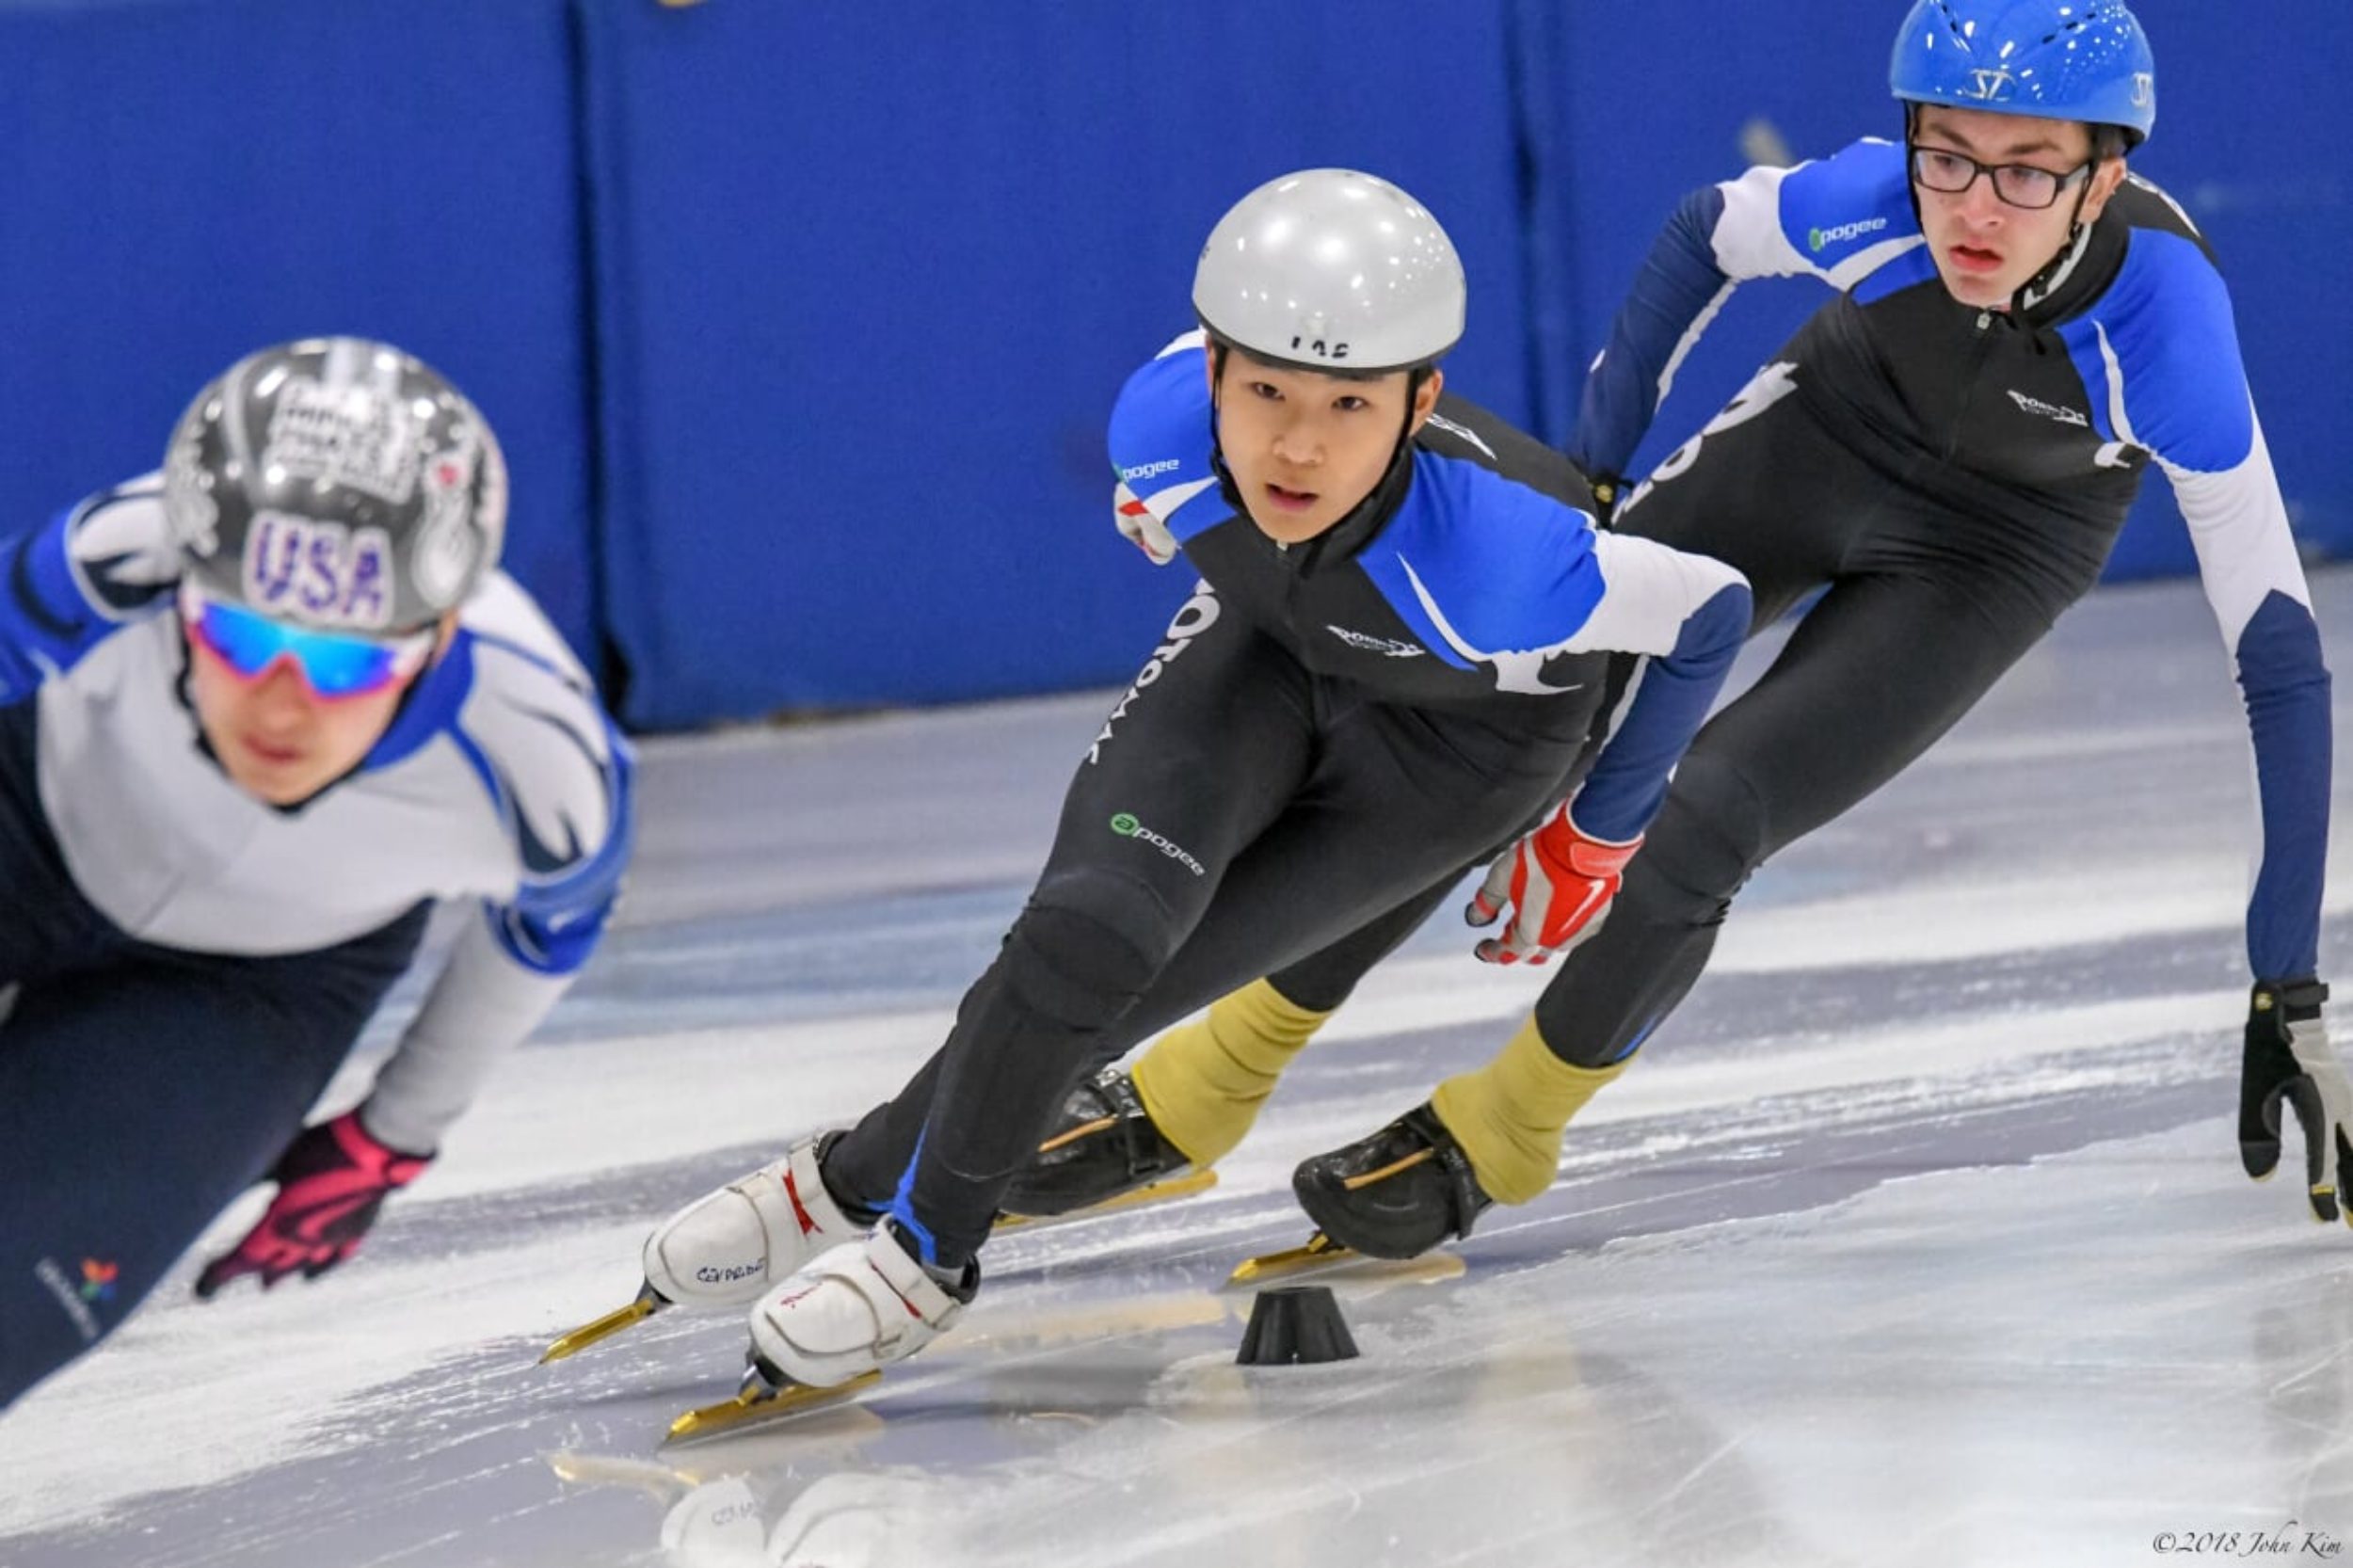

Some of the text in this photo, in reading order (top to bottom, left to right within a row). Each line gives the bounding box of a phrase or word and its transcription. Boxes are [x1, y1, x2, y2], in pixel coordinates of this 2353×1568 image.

[1809, 217, 1886, 252] pogee
[1112, 459, 1179, 483] pogee
[256, 521, 381, 616] USA
